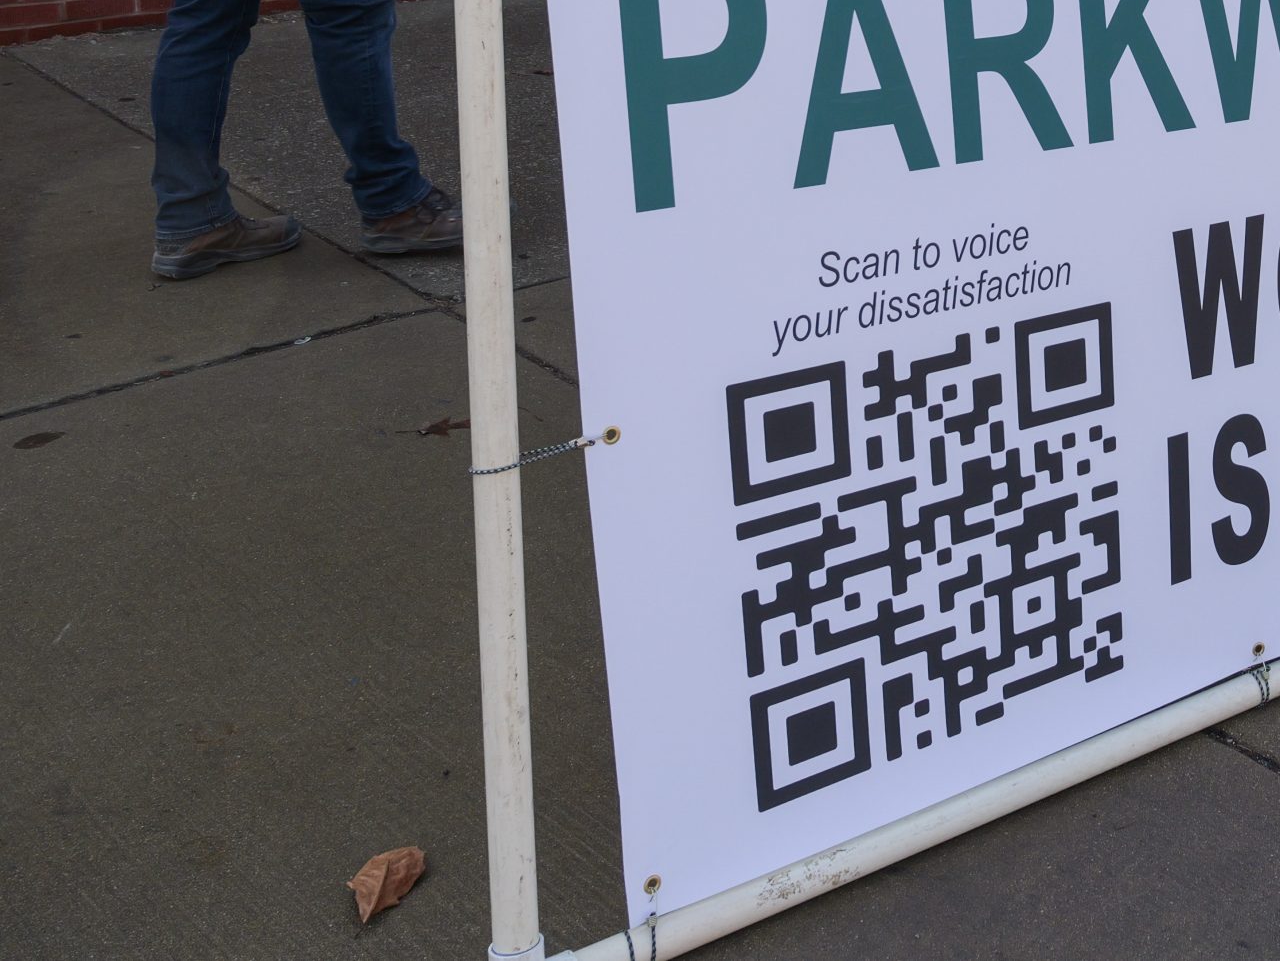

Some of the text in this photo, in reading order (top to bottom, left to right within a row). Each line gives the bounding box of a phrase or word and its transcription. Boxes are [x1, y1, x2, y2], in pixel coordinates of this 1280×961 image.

[818, 224, 1030, 288] Scan to voice
[771, 259, 1072, 358] your dissatisfaction
[1165, 413, 1272, 586] IS
